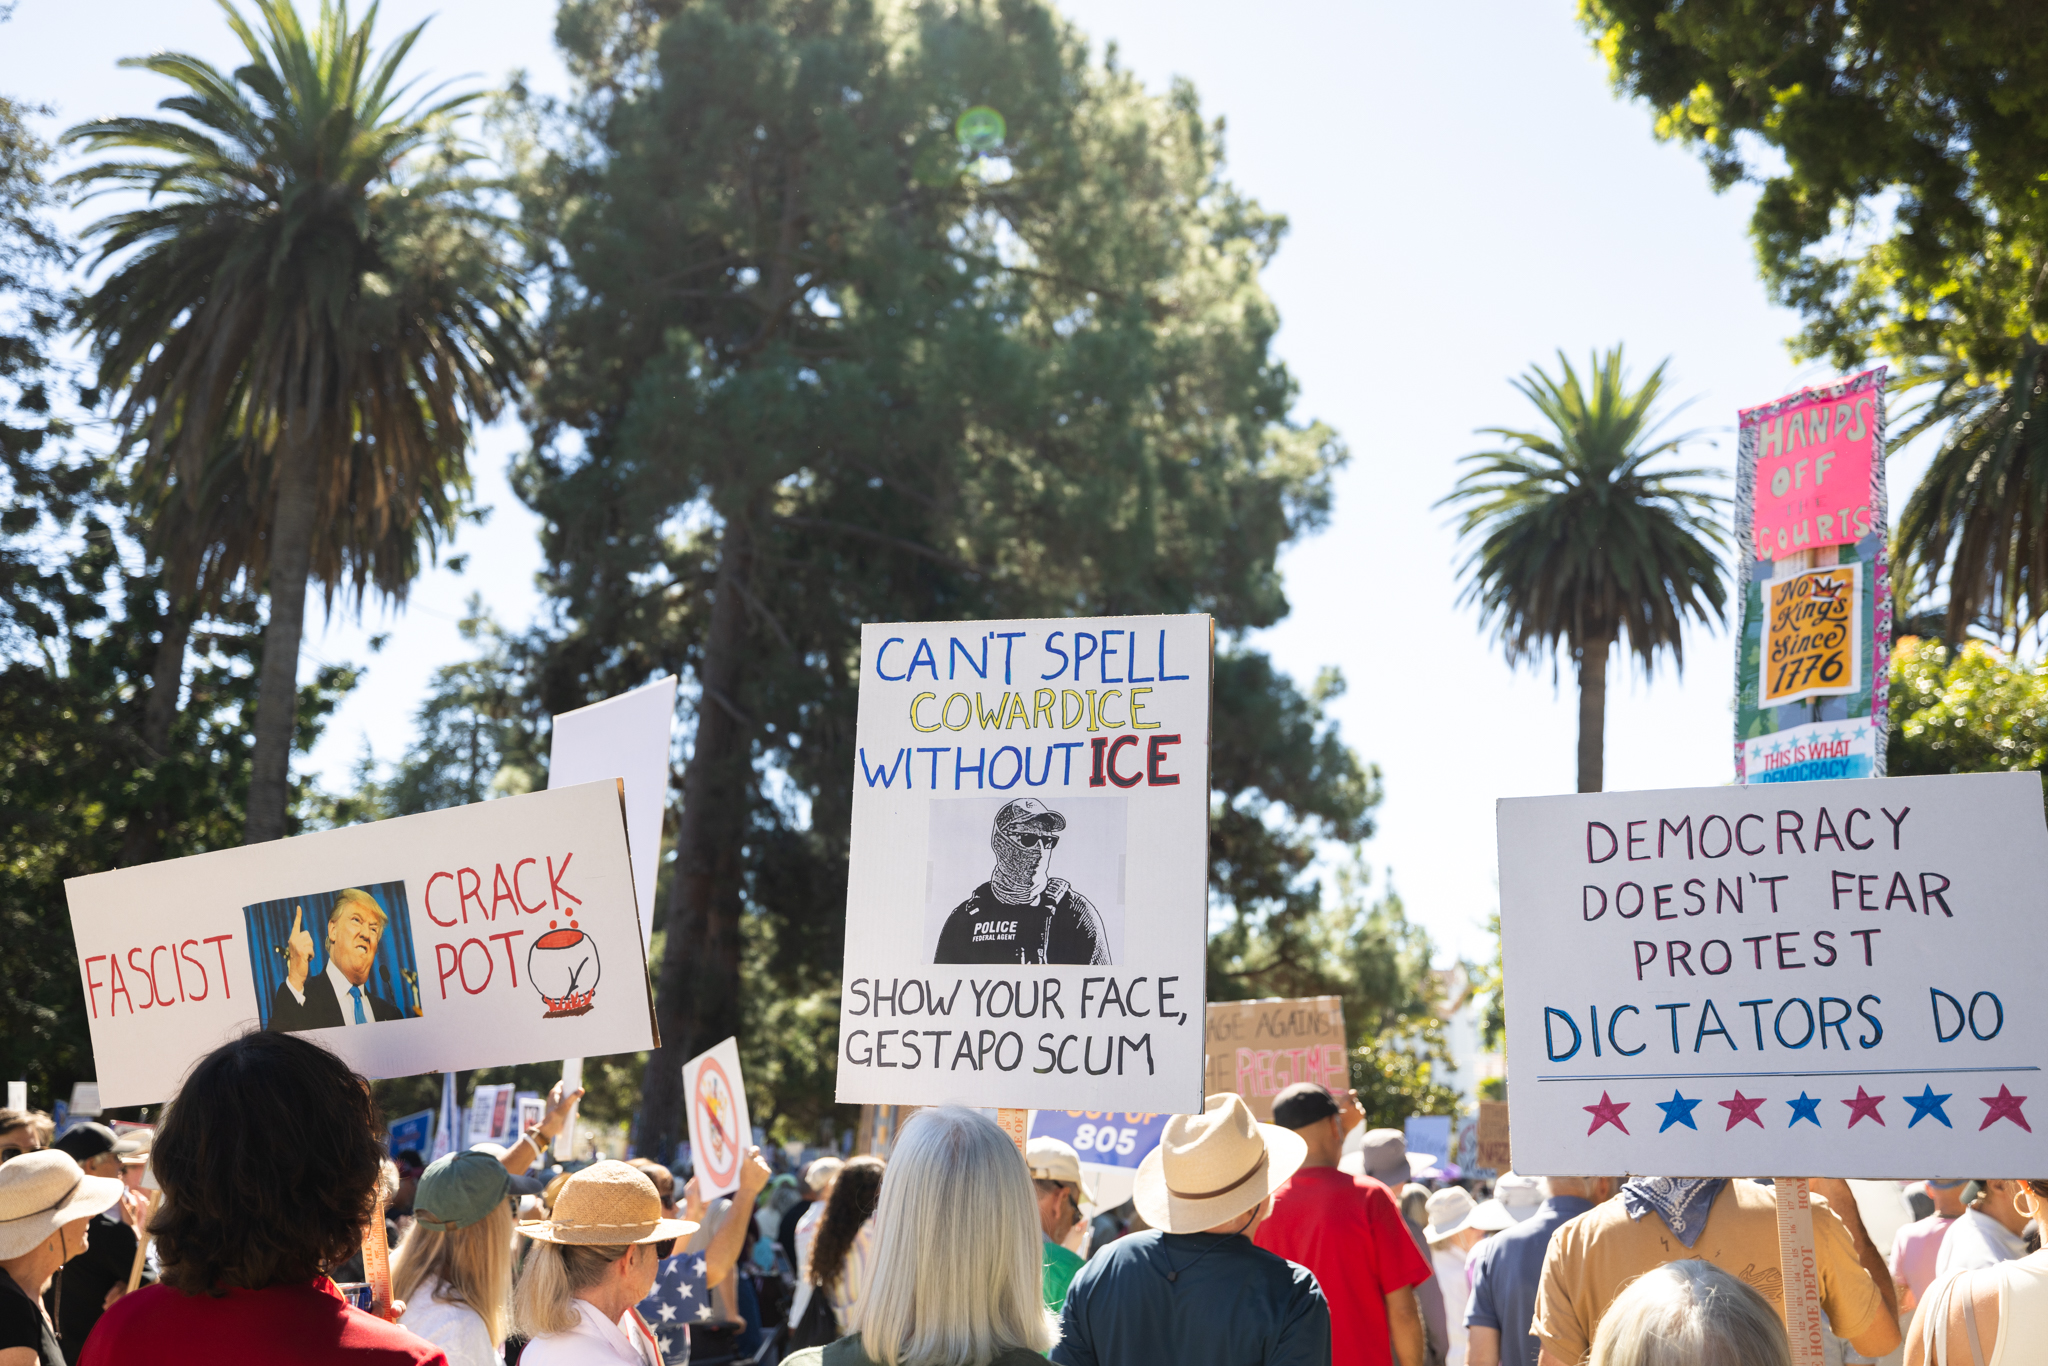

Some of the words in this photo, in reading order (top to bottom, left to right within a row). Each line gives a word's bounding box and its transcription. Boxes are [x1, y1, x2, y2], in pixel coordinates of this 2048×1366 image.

[1758, 398, 1872, 459] HANDS
[1770, 451, 1836, 498] OFF
[1759, 505, 1870, 559] COURTS
[1772, 598, 1848, 632] Kings
[1776, 577, 1810, 606] No
[876, 631, 1026, 685] CAN'T
[1041, 629, 1190, 683] SPELL
[1771, 624, 1847, 662] Since
[1772, 650, 1844, 694] 1776
[909, 687, 1161, 732] COWARDICE
[859, 741, 1084, 790] WITHOUT
[1089, 734, 1182, 788] ICE
[1763, 750, 1791, 771] THIS
[1794, 745, 1806, 763] IS
[1808, 739, 1851, 759] WHAT
[1763, 758, 1850, 783] DEMOCRACY
[1587, 806, 1911, 864] DEMOCRACY
[424, 852, 582, 927] CRACK
[1583, 872, 1789, 921] DOESN'T
[1831, 870, 1954, 918] FEAR
[972, 934, 995, 942] FEDERAL
[996, 933, 1016, 941] AGENT
[973, 920, 1018, 935] POLICE
[84, 934, 233, 1019] FASCIST
[435, 929, 524, 1000] POT
[1633, 928, 1881, 981] PROTEST
[848, 977, 962, 1018] SHOW
[970, 977, 1065, 1020] YOUR
[1081, 976, 1188, 1027] FACE,
[1544, 994, 1884, 1062] DICTATORS
[1929, 986, 2004, 1043] DO
[1206, 1013, 1247, 1043] AGE
[1255, 1008, 1340, 1039] AGAINST
[845, 1029, 1024, 1072] GESTAPO
[1033, 1032, 1155, 1076] SCUM
[1206, 1053, 1234, 1091] HE
[1235, 1044, 1347, 1097] REGIME
[1014, 1116, 1024, 1133] OF
[1072, 1123, 1138, 1155] 805
[1797, 1178, 1809, 1210] HOM
[365, 1245, 374, 1270] THE
[1800, 1245, 1818, 1301] DEPOT
[1806, 1305, 1823, 1357] HOME
